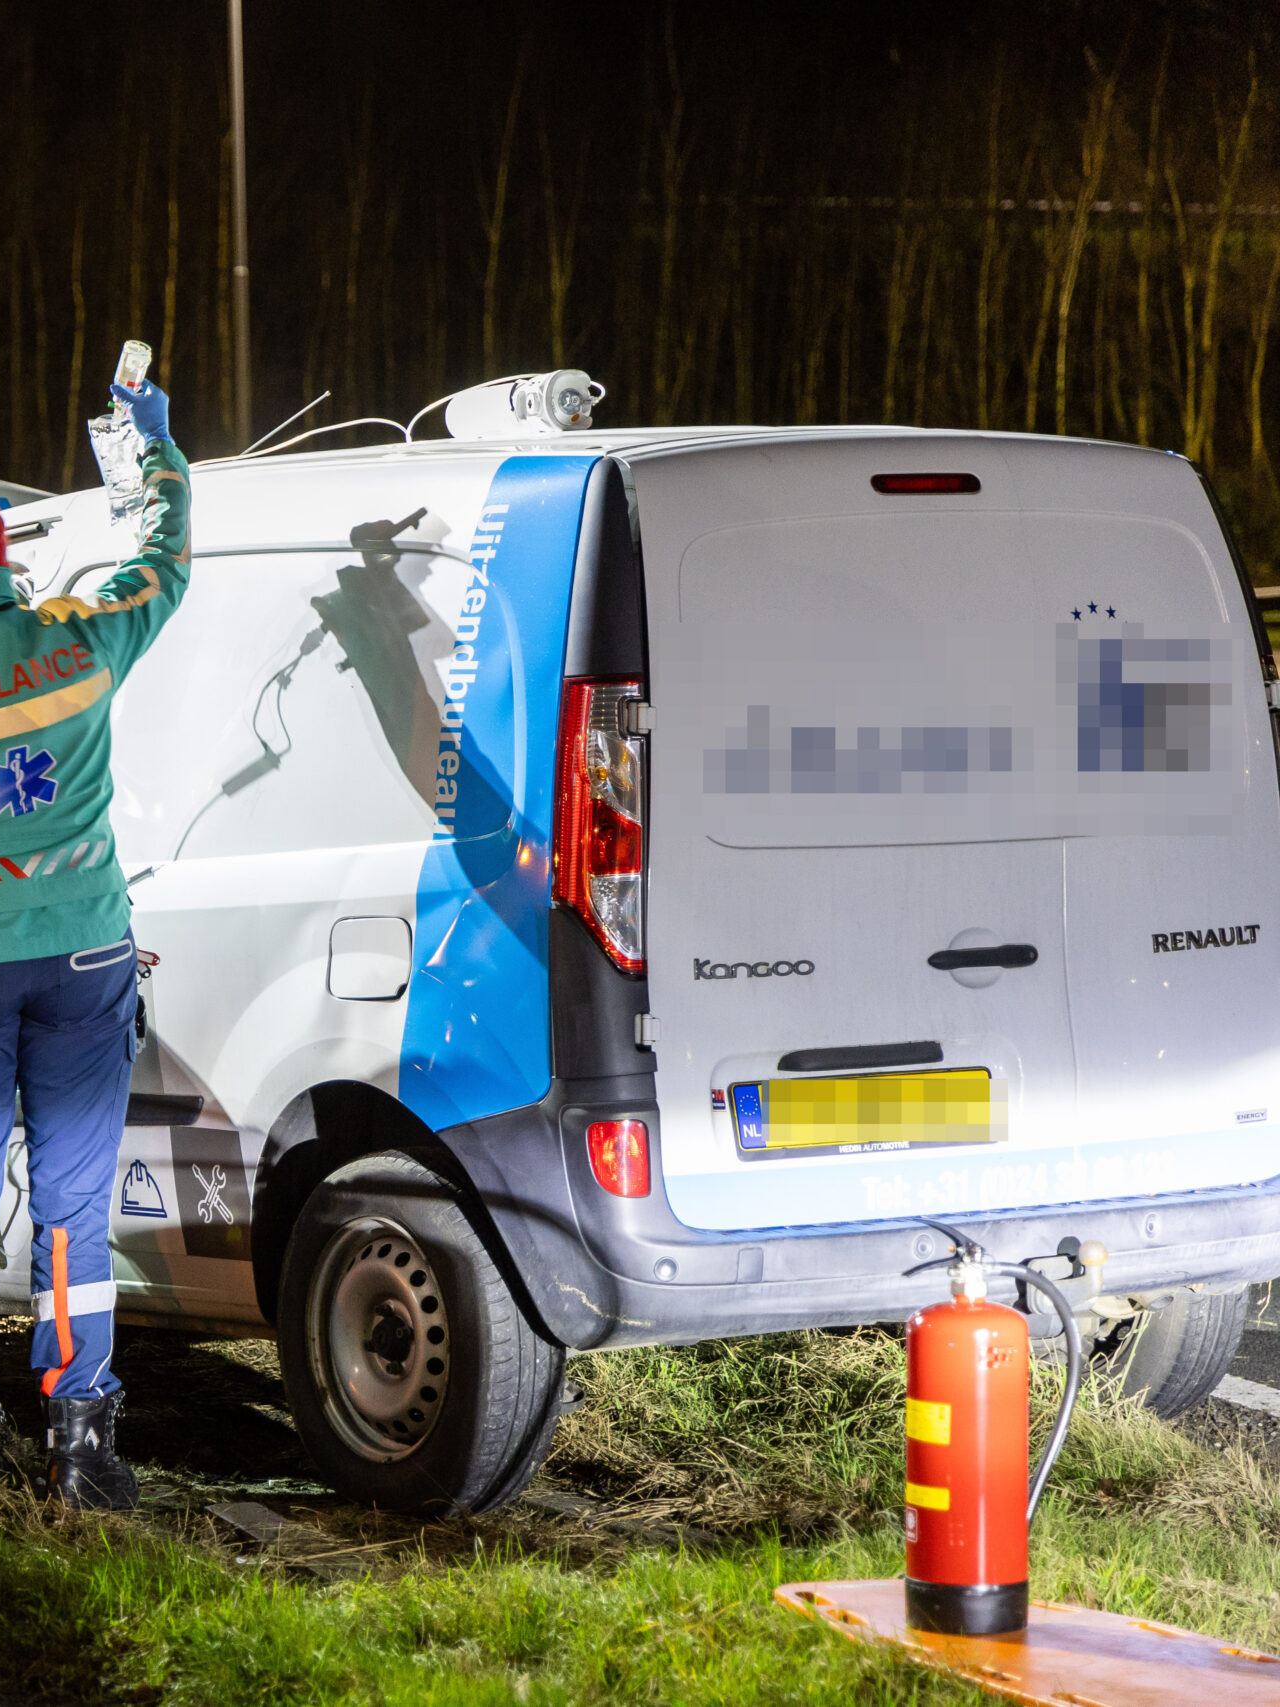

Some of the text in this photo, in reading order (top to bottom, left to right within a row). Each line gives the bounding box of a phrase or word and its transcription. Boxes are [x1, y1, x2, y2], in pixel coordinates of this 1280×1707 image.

[433, 503, 508, 838] Uitzendbureau
[1151, 924, 1261, 954] RENAULT
[743, 1123, 762, 1138] NL
[863, 1140, 910, 1152] AUTOMOTIVE
[861, 1174, 911, 1211] Tel:
[917, 1169, 969, 1206] +31
